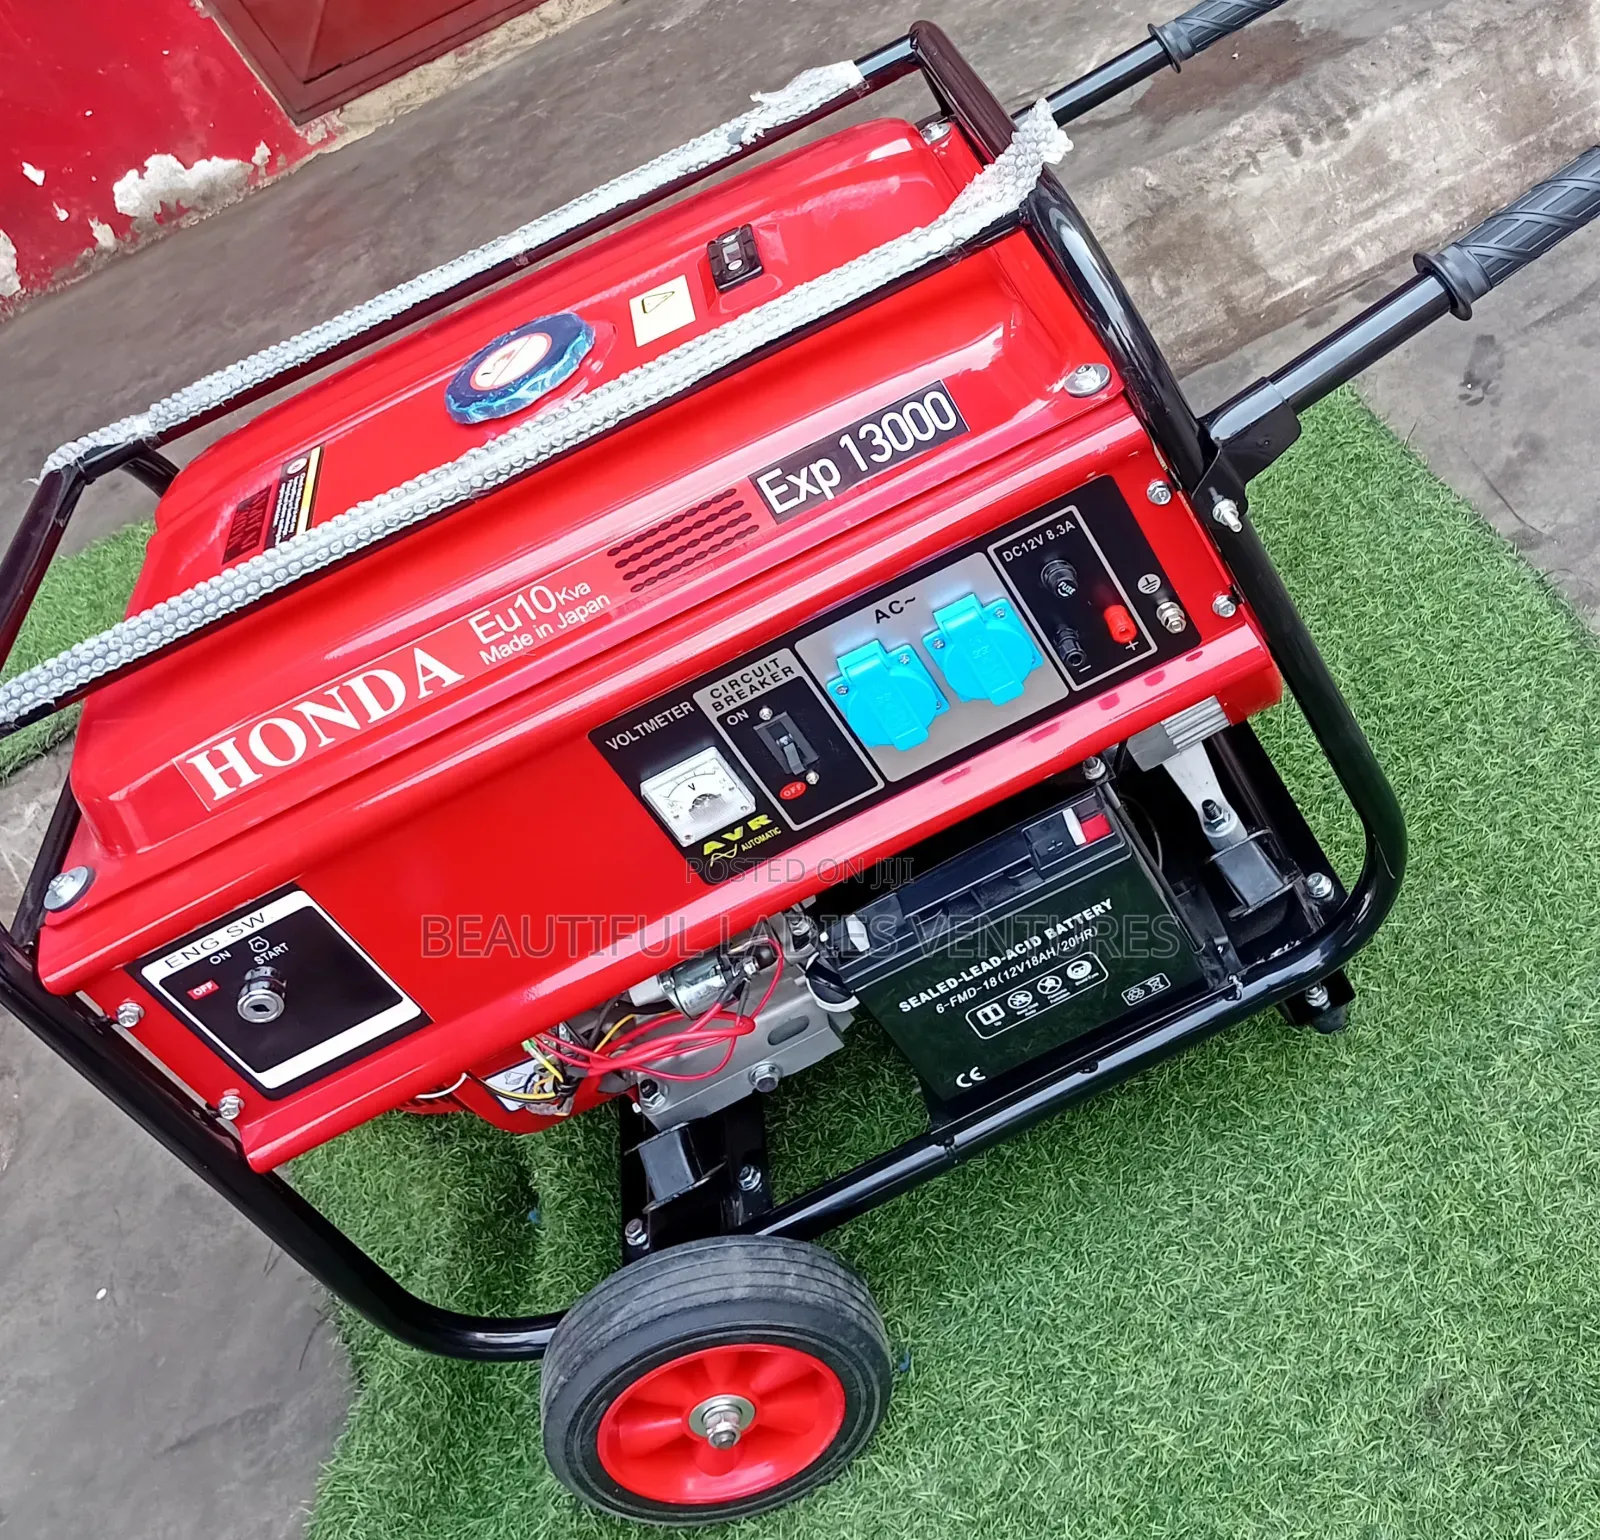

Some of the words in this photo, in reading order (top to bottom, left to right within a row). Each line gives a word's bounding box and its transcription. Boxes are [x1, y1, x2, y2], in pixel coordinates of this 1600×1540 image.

[756, 457, 842, 514] Exp
[838, 390, 957, 472] 13000
[1001, 533, 1045, 563] DC12V
[1045, 519, 1077, 542] 8.3A
[478, 631, 534, 666] Made
[532, 623, 555, 640] in
[557, 594, 611, 630] Japan
[709, 657, 782, 699] CIRCUIT
[711, 665, 795, 713] BREAKER
[185, 646, 465, 801] HONDA
[605, 700, 695, 751] VOLTMETER
[726, 708, 750, 727] ON
[783, 783, 804, 797] OFF
[740, 826, 782, 852] AUTOMATIC
[209, 949, 232, 965] ON
[253, 942, 290, 965] START
[898, 934, 1042, 1013] SEALED-LEAD-ACID
[1043, 897, 1115, 941] BATTERY
[193, 982, 214, 996] OFF
[955, 1065, 987, 1089] CE
